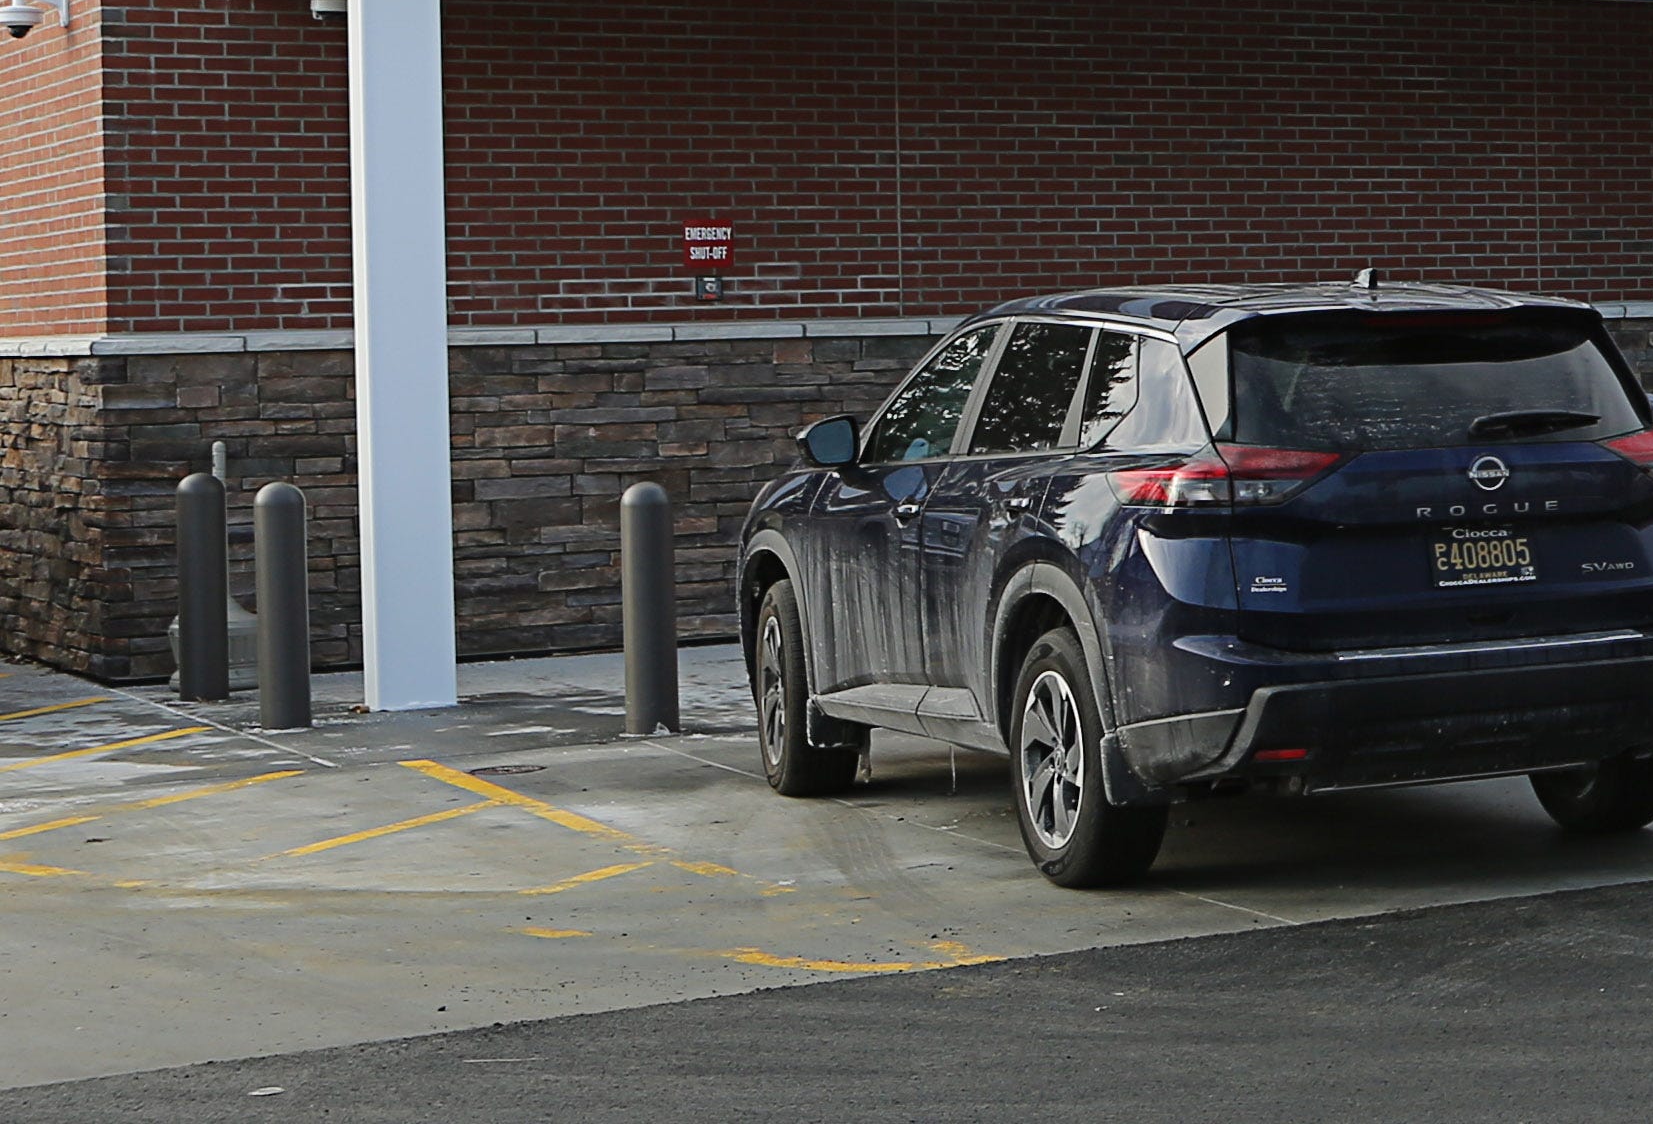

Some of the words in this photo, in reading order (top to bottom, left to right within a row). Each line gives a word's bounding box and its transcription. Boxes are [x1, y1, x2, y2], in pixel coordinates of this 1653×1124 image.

[684, 227, 732, 241] EMERGENCY
[689, 246, 728, 260] SHUT-OFF
[1469, 469, 1510, 479] NISSAN
[1416, 500, 1559, 518] ROGUE
[1452, 528, 1508, 539] Ciocca
[1450, 538, 1530, 570] 408805
